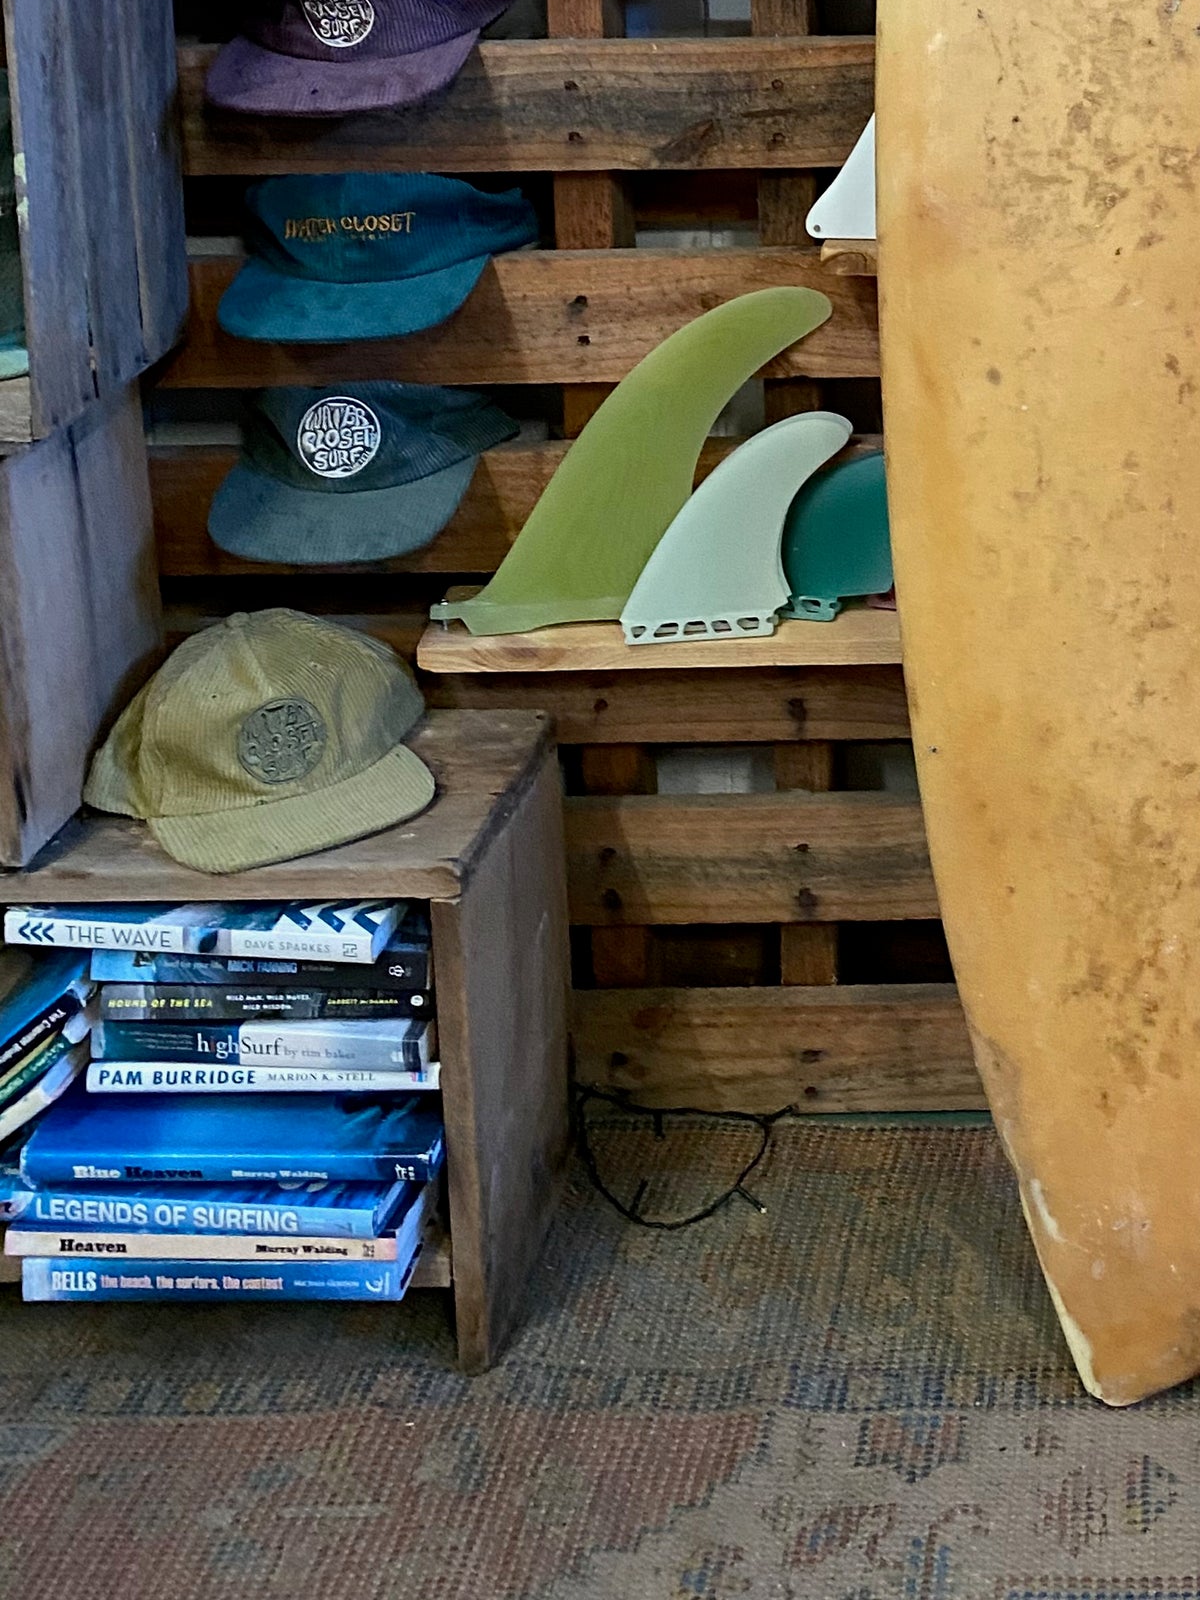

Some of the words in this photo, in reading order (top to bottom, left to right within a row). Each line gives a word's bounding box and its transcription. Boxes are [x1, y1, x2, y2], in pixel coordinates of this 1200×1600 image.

[319, 18, 361, 38] SURF
[340, 211, 416, 233] CLOSET
[304, 402, 370, 431] WATER
[302, 425, 375, 453] CLOSET
[313, 446, 364, 470] SURF
[65, 925, 105, 944] THE
[111, 928, 172, 948] WAVE
[244, 940, 274, 950] DAVE
[278, 942, 331, 953] SPARKES
[108, 999, 147, 1008] HOUND
[151, 999, 166, 1008] OF
[170, 999, 190, 1008] THE
[193, 998, 213, 1008] SEA
[284, 1046, 298, 1060] by
[302, 1048, 321, 1058] tim
[99, 1070, 142, 1085] PAM
[153, 1070, 256, 1085] BURRIDGE
[267, 1072, 317, 1081] MARION
[337, 1073, 376, 1082] STELL
[73, 1166, 121, 1179] Blue
[124, 1166, 203, 1179] Heaven
[231, 1170, 277, 1180] Murray
[279, 1170, 328, 1180] Walding
[36, 1197, 149, 1225] LEGENDS
[154, 1204, 187, 1226] OF
[193, 1207, 298, 1232] SURFING
[59, 1238, 128, 1253] Heaven
[256, 1244, 299, 1255] Murray
[301, 1245, 348, 1256] Walding
[51, 1271, 97, 1291] BELLS
